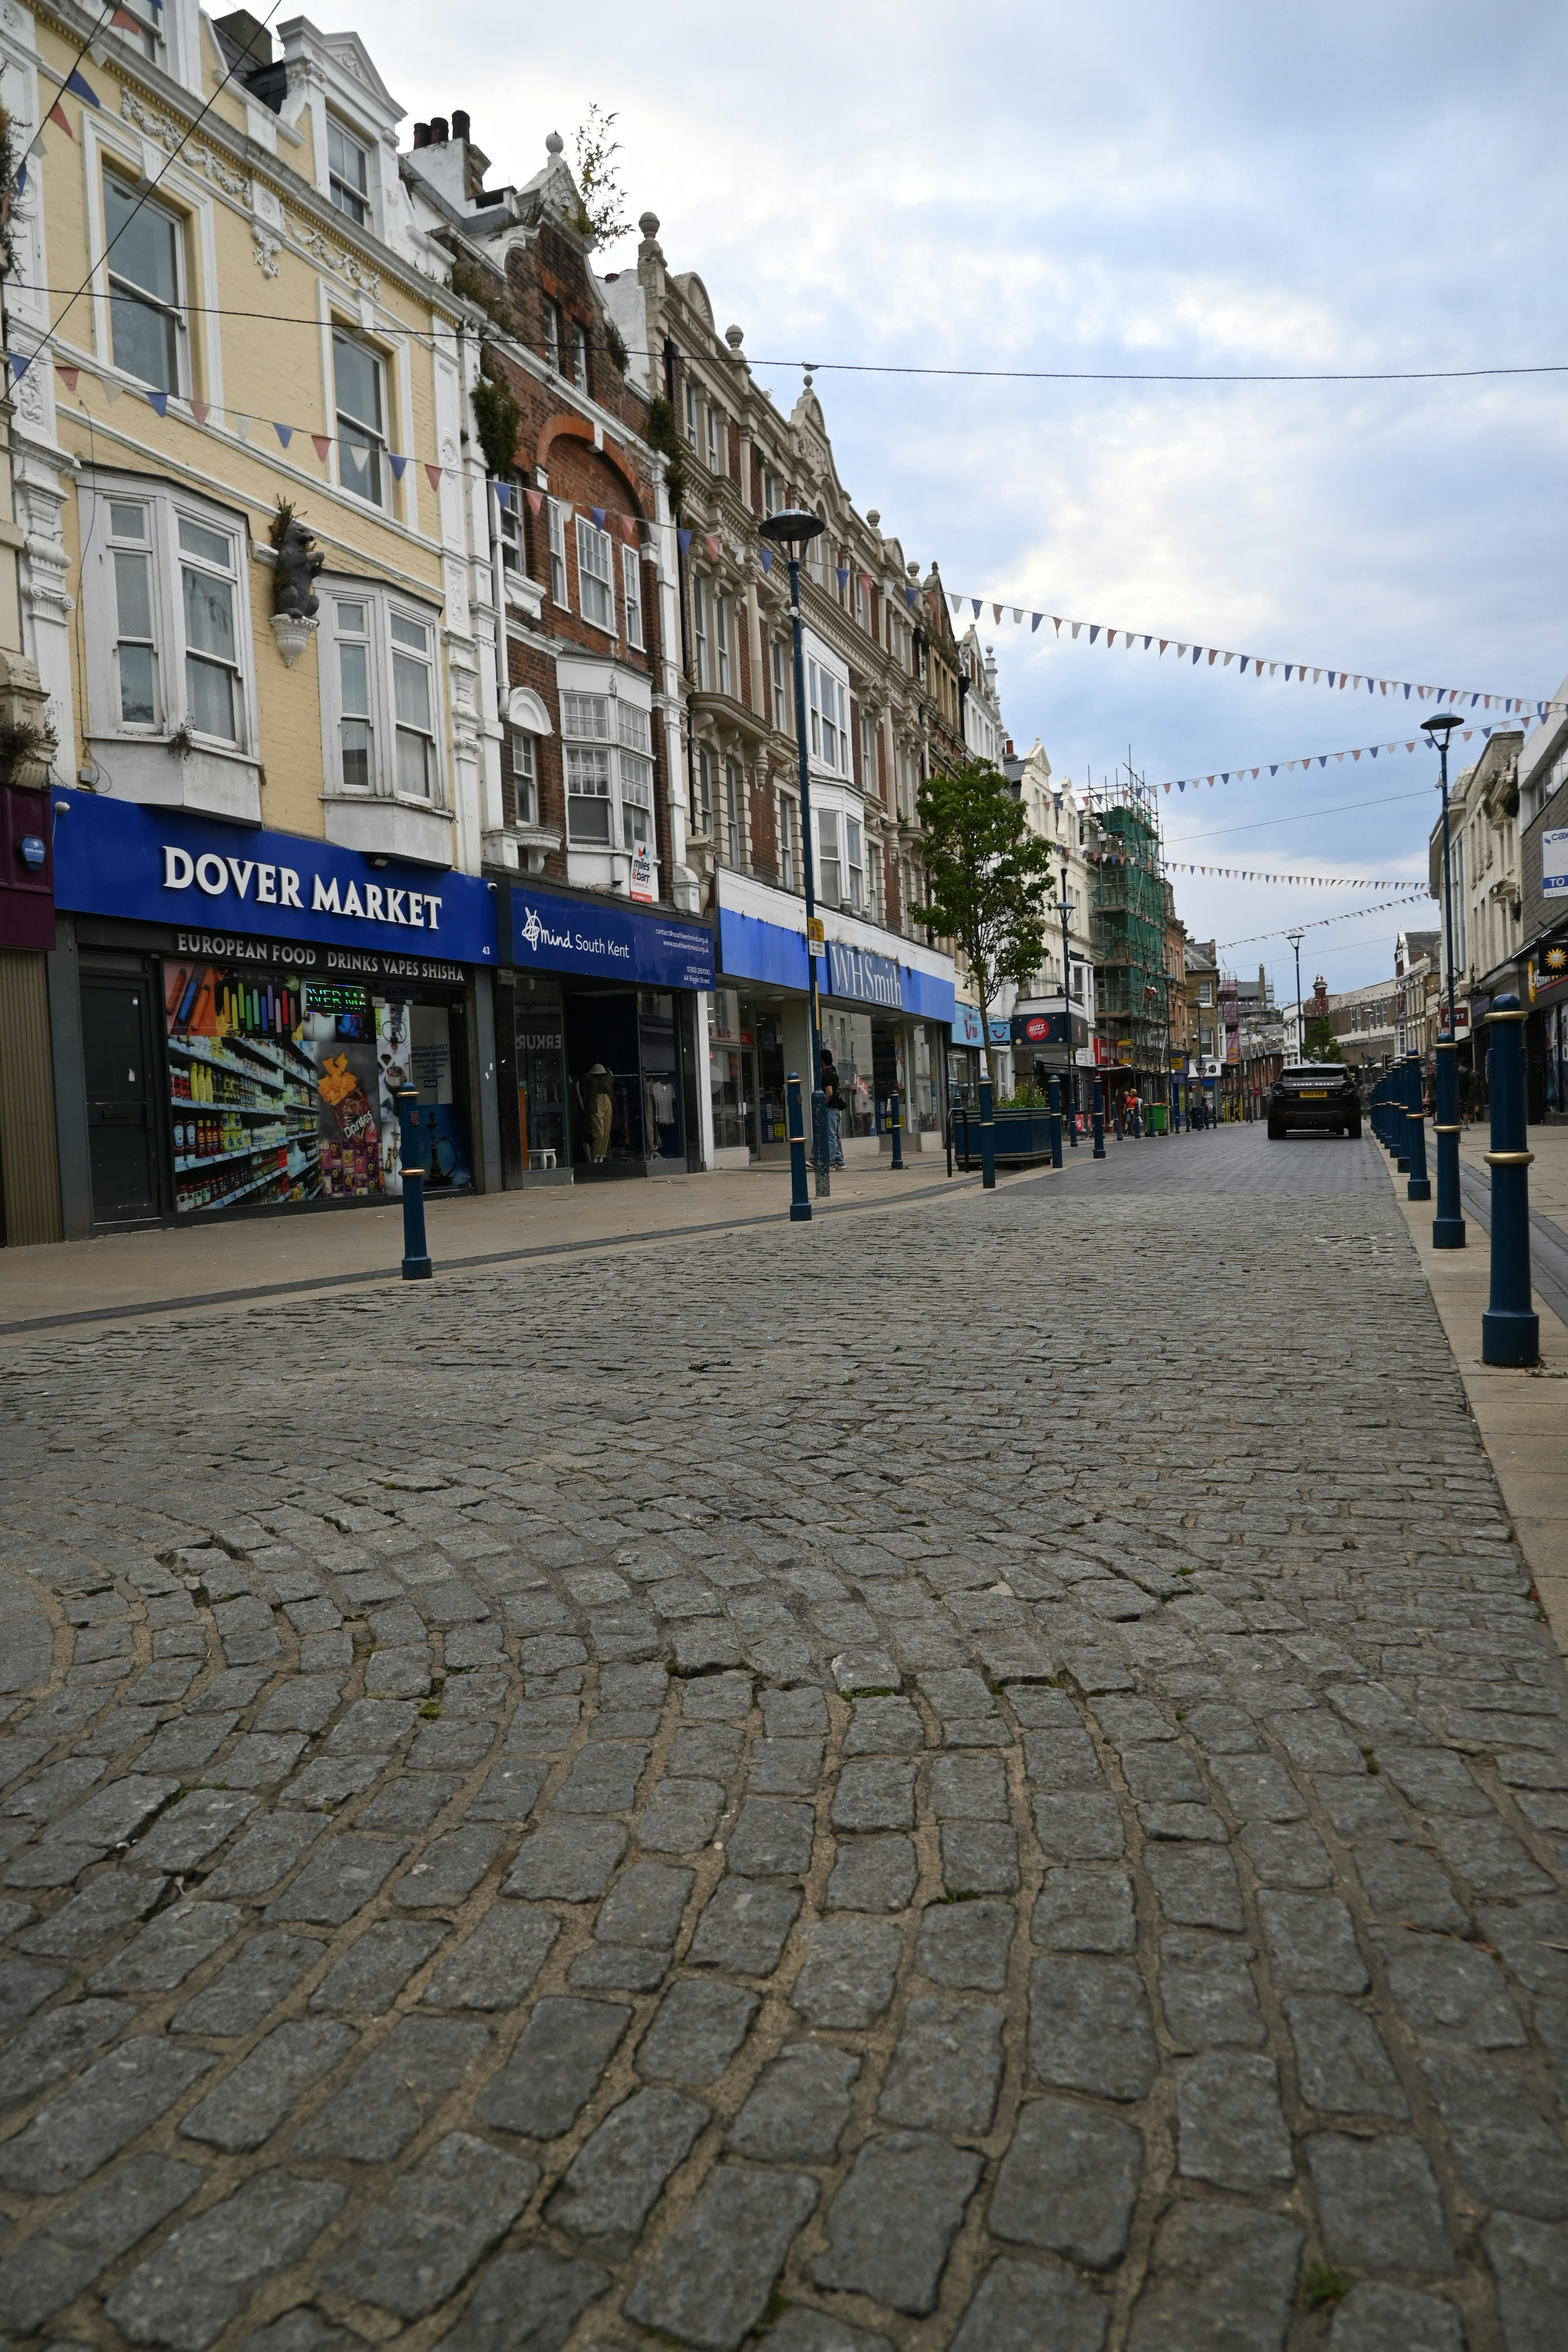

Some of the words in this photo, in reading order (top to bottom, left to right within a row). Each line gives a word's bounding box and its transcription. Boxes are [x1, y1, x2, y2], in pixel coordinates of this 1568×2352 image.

[634, 858, 650, 871] miles
[163, 846, 304, 908] DOVER
[311, 874, 442, 929] MARKET
[1549, 877, 1565, 887] TO
[541, 929, 573, 949] mind
[575, 934, 605, 954] South
[608, 940, 630, 958] Kent
[655, 928, 709, 945] contact@southkentmind.org.uk
[482, 946, 490, 955] 43
[663, 940, 709, 954] www.southkentmind.org.uk
[177, 933, 267, 960] EUROPEAN
[272, 945, 316, 965] FOOD
[327, 951, 378, 972] DRINKS
[381, 958, 419, 976] VAPES
[422, 963, 464, 981] SHISHA
[689, 975, 700, 984] Biggin
[830, 945, 903, 1006] WHSmith
[1029, 1023, 1045, 1032] BUZZ
